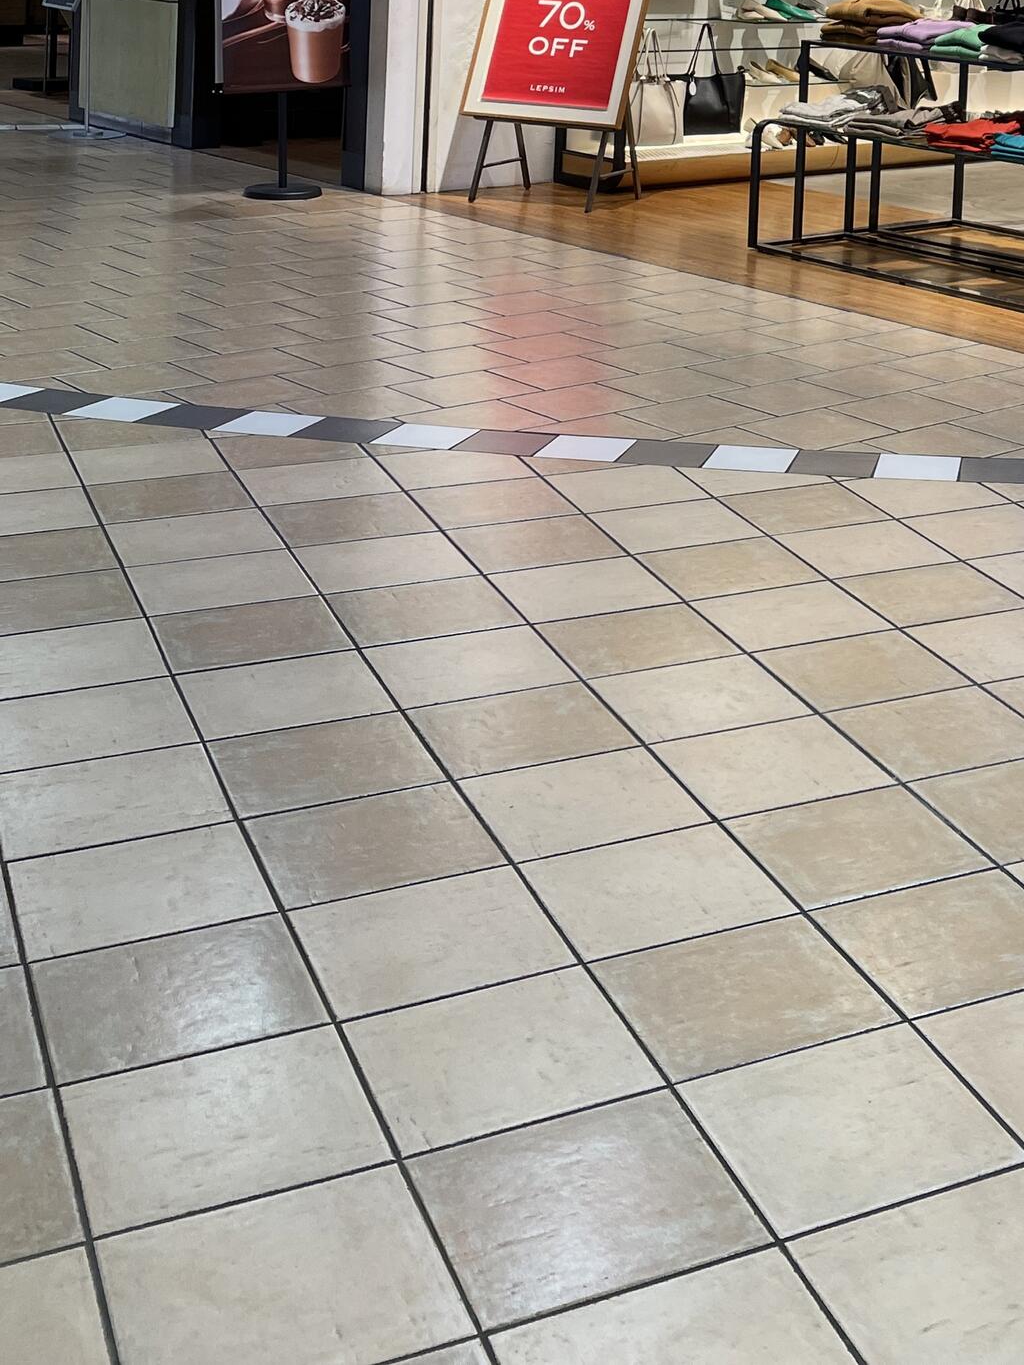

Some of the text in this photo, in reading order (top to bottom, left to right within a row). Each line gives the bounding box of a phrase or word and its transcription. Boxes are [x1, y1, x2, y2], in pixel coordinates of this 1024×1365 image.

[538, 0, 596, 31] 70%
[528, 36, 589, 58] OFF
[530, 84, 566, 94] LEPSIM
